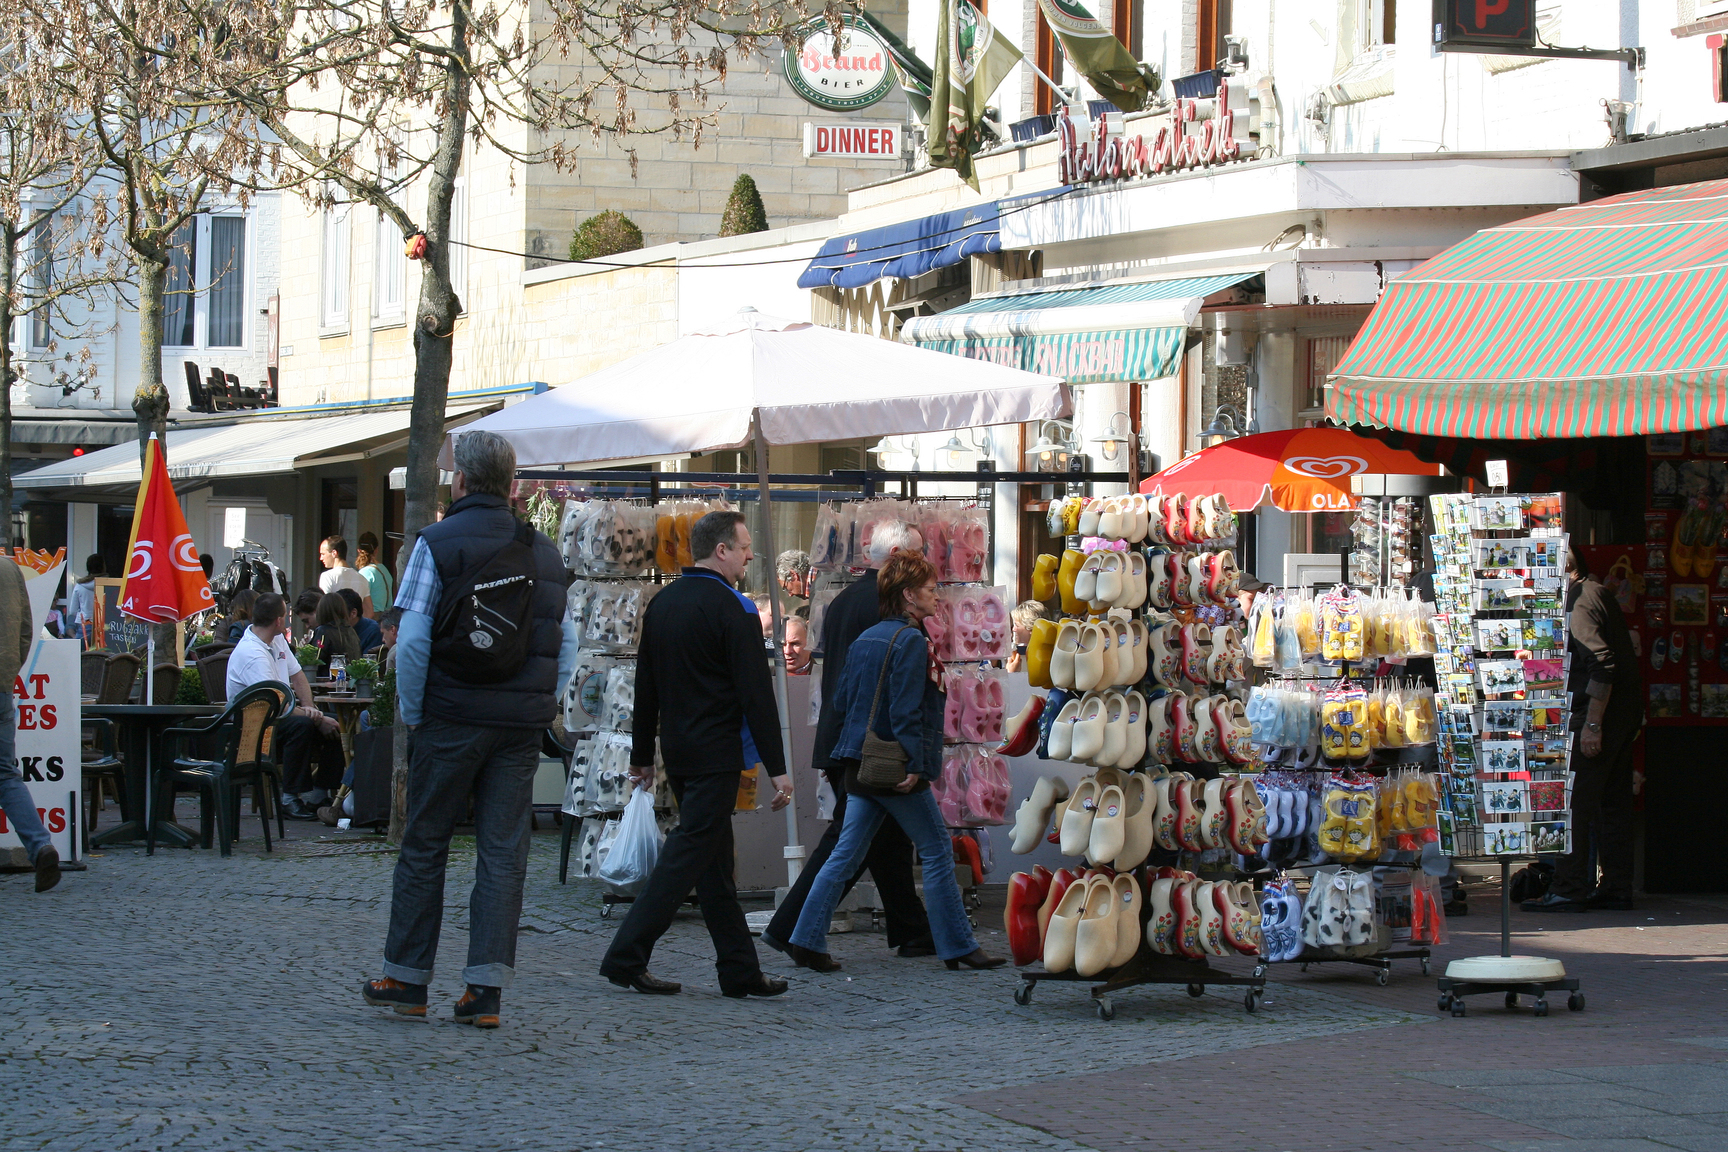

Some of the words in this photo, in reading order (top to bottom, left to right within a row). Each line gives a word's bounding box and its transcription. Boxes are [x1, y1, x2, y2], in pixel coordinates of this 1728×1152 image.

[802, 44, 883, 73] Brand
[820, 78, 864, 89] BIER
[816, 127, 894, 154] DINNER
[1037, 338, 1125, 376] SNACKBAR
[1311, 493, 1351, 509] OLA
[474, 575, 526, 591] BATAVUS
[13, 756, 64, 782] KS
